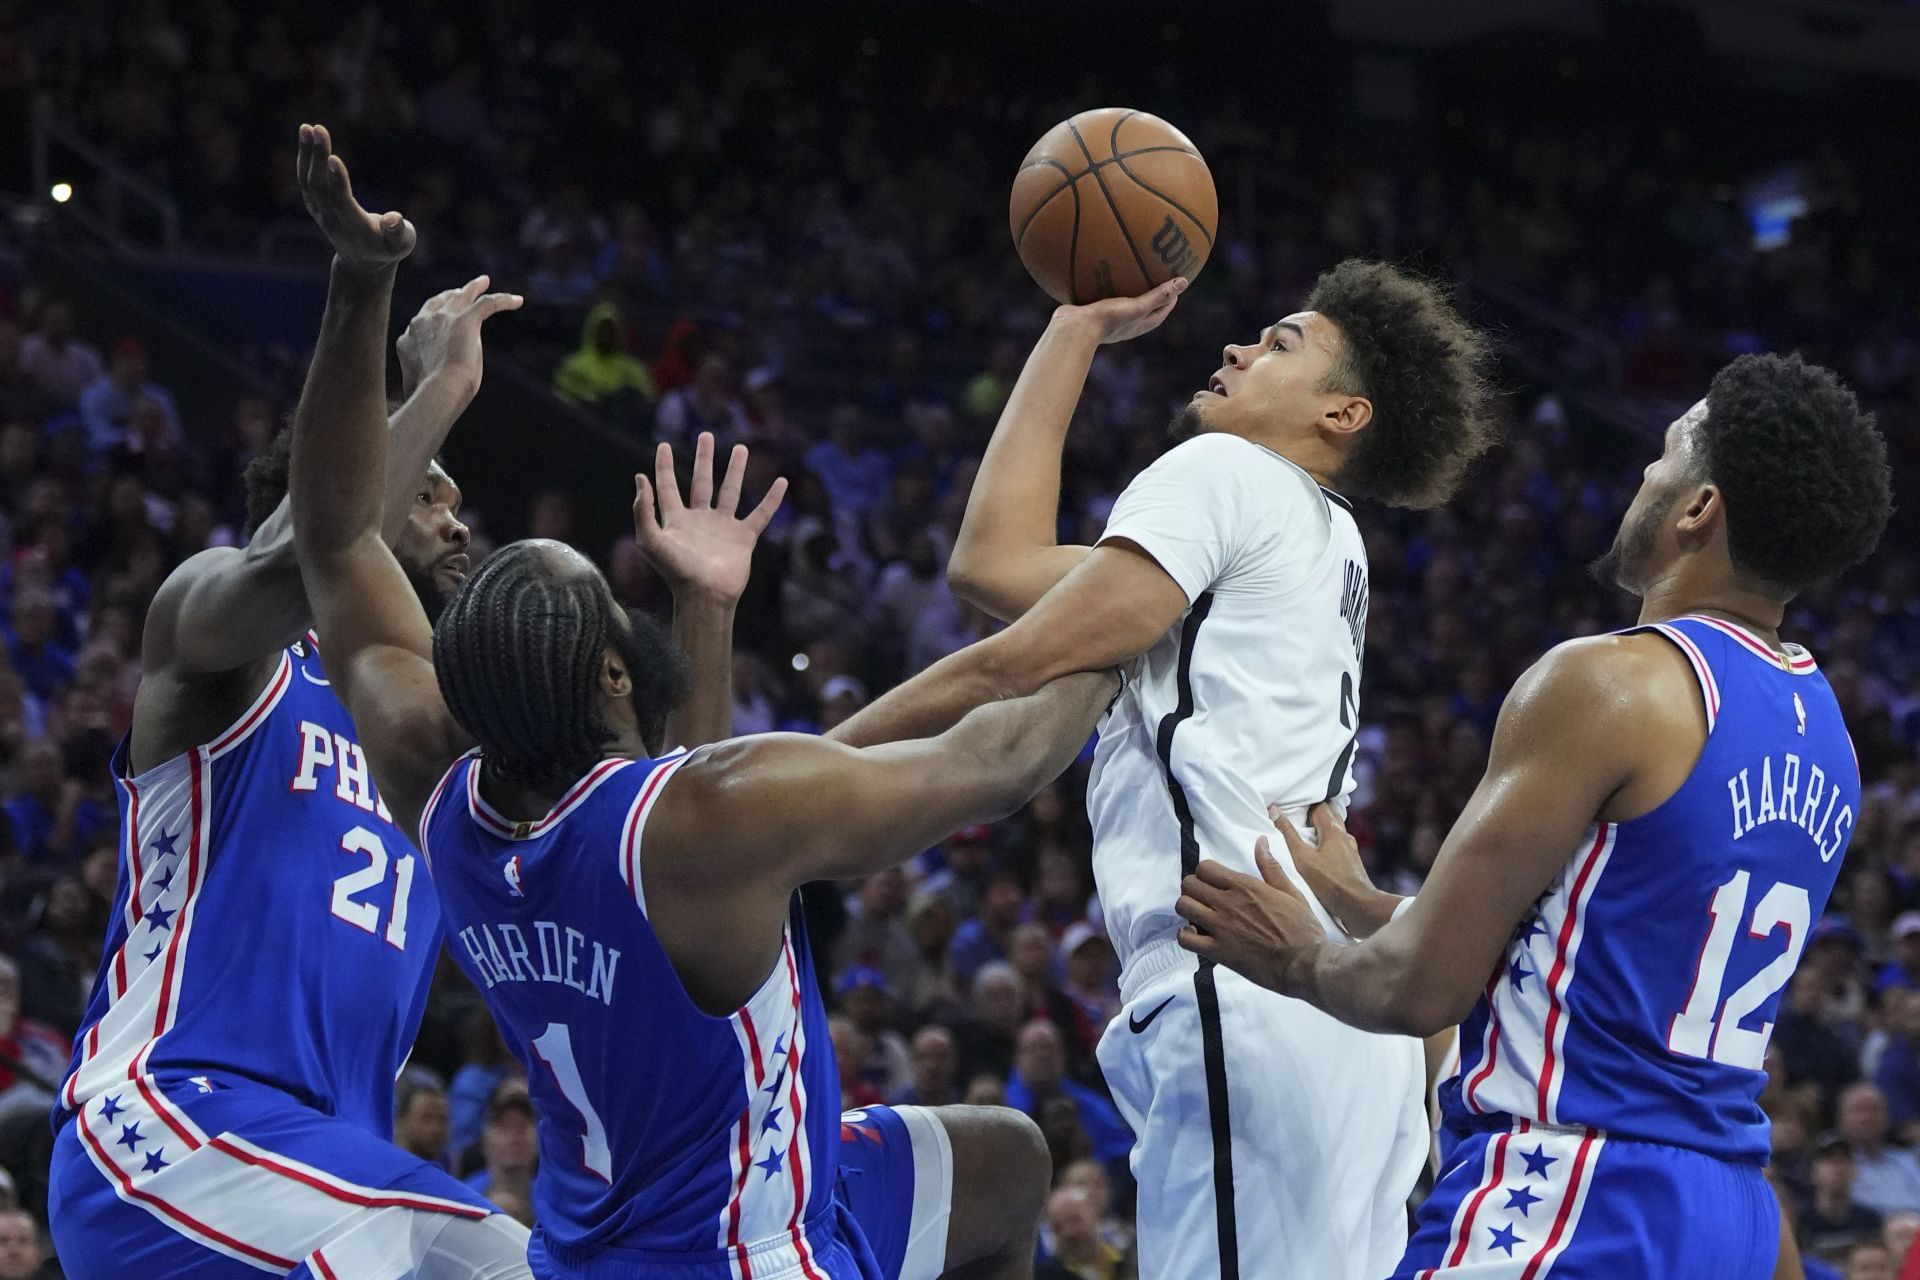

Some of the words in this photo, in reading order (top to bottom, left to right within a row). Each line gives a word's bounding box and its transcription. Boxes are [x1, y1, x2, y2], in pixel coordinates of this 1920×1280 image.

[289, 720, 393, 824] PH
[1728, 753, 1852, 863] HARRIS
[331, 826, 415, 951] 21
[459, 921, 622, 1006] HARDEN
[1668, 869, 1811, 1071] 12
[532, 1022, 613, 1187] 1
